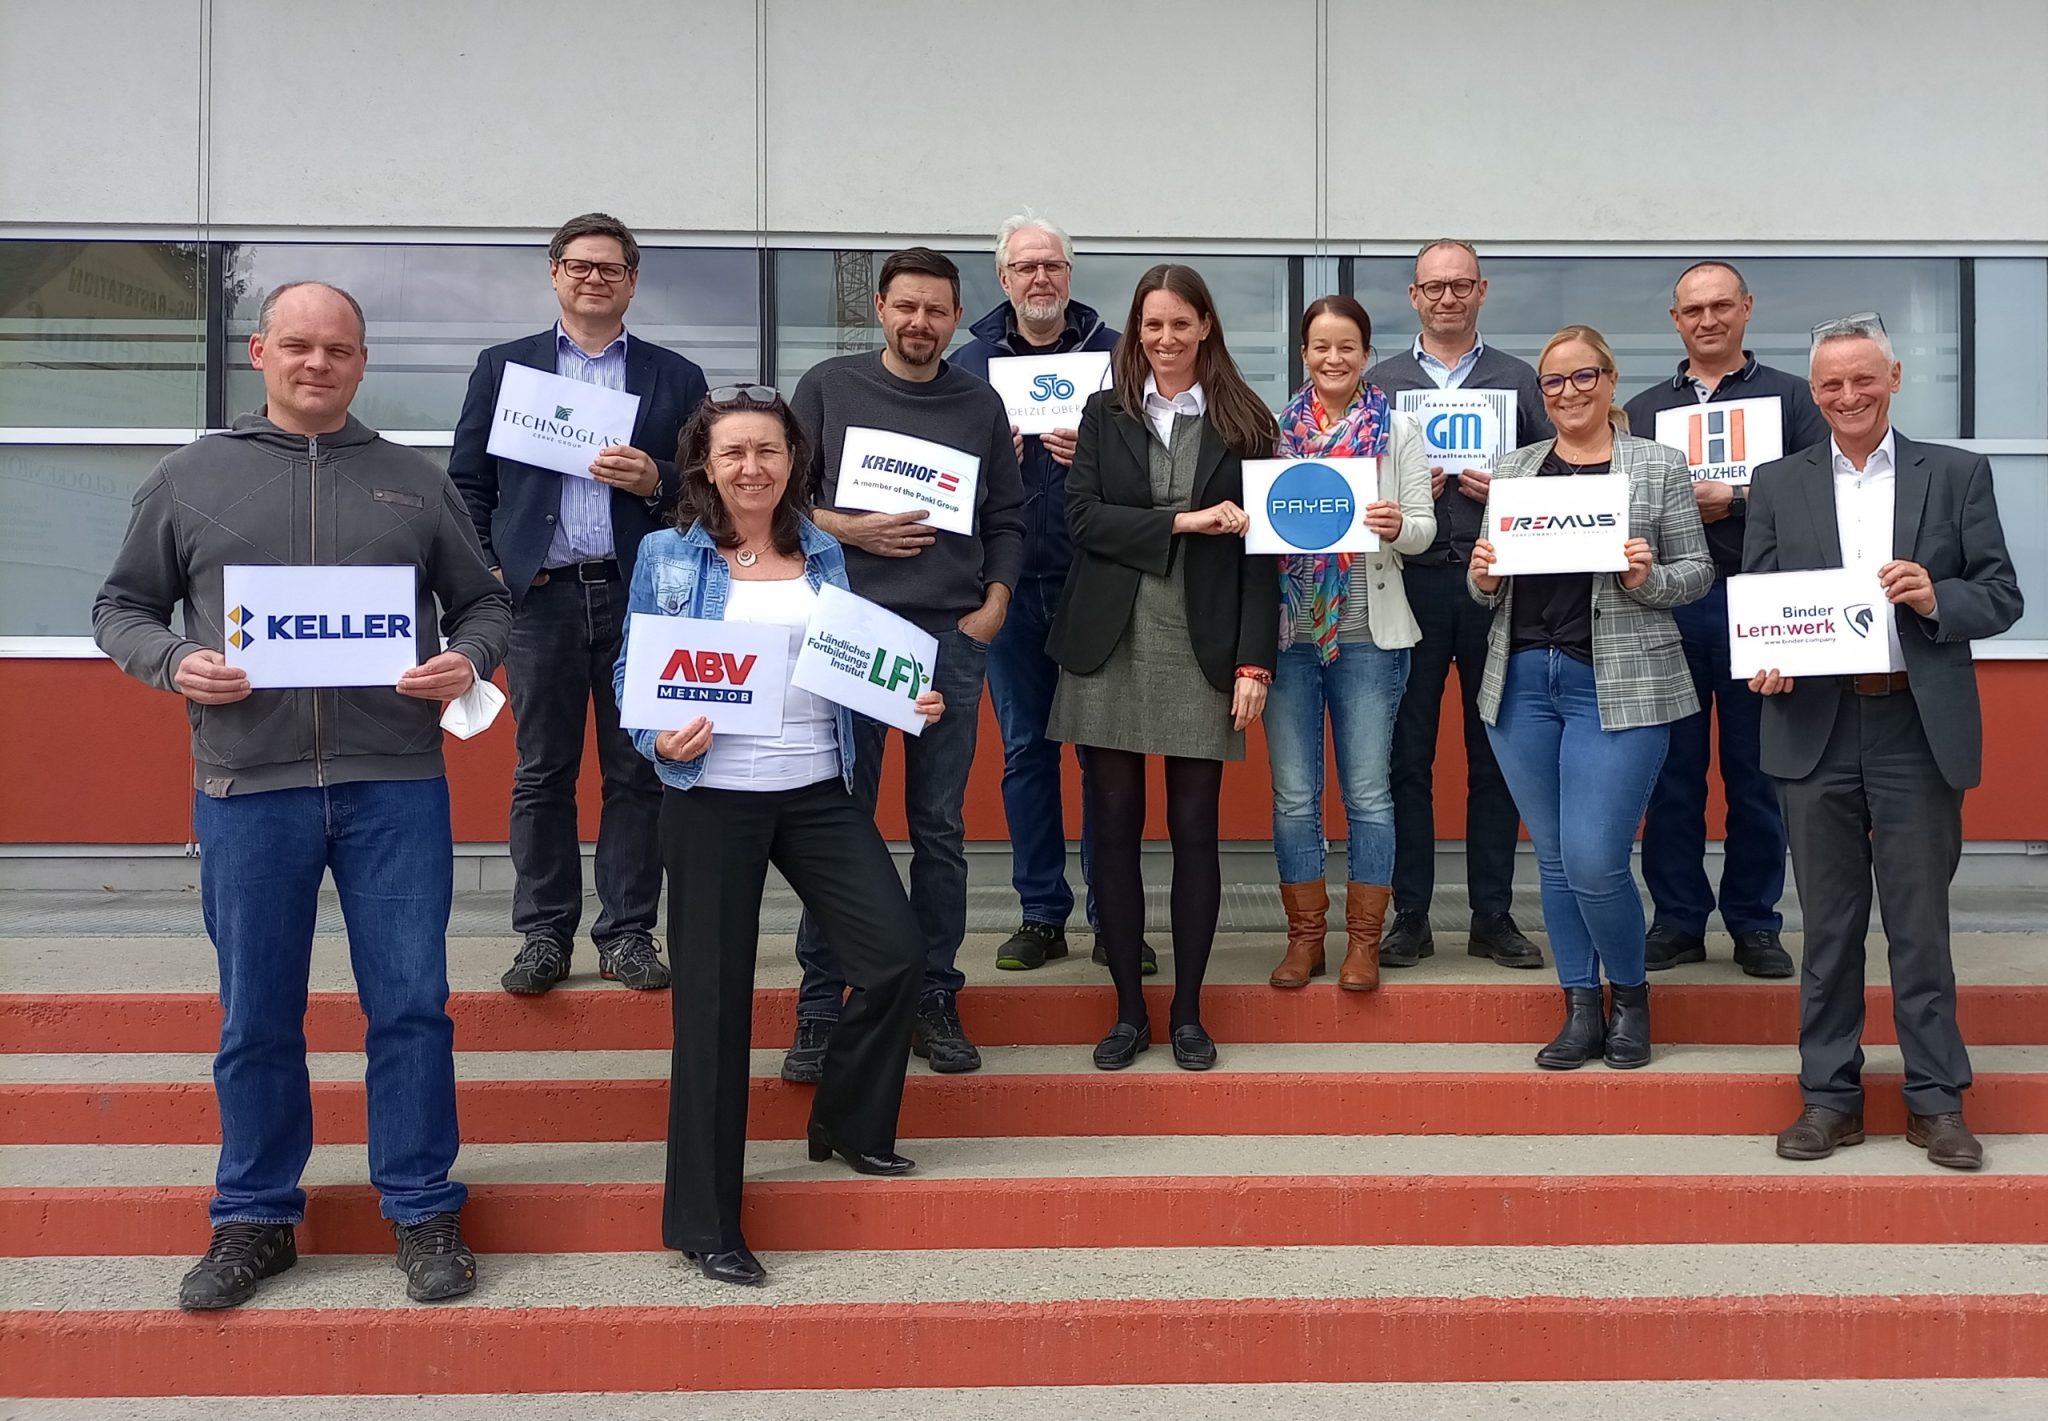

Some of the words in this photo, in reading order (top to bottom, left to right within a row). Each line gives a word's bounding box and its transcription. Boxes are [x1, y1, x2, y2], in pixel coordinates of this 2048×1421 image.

[502, 408, 622, 448] TECHNOGLAS
[1426, 413, 1482, 450] GM
[861, 454, 938, 483] KRENHOF
[1689, 465, 1747, 481] HOLZHER
[860, 480, 892, 492] member
[902, 488, 915, 498] the
[916, 492, 936, 505] Pankl
[936, 499, 959, 513] Group
[1272, 498, 1350, 514] PAYER
[1512, 513, 1617, 531] REMUS
[1782, 605, 1834, 618] Binder
[267, 614, 412, 640] KELLER
[1737, 618, 1836, 638] Lern:werk
[807, 637, 868, 669] Fortbildungs
[819, 631, 871, 660] Ländliches
[659, 648, 758, 686] ABV
[830, 657, 865, 679] Institut
[659, 686, 709, 700] MEIN
[715, 690, 750, 702] JOB
